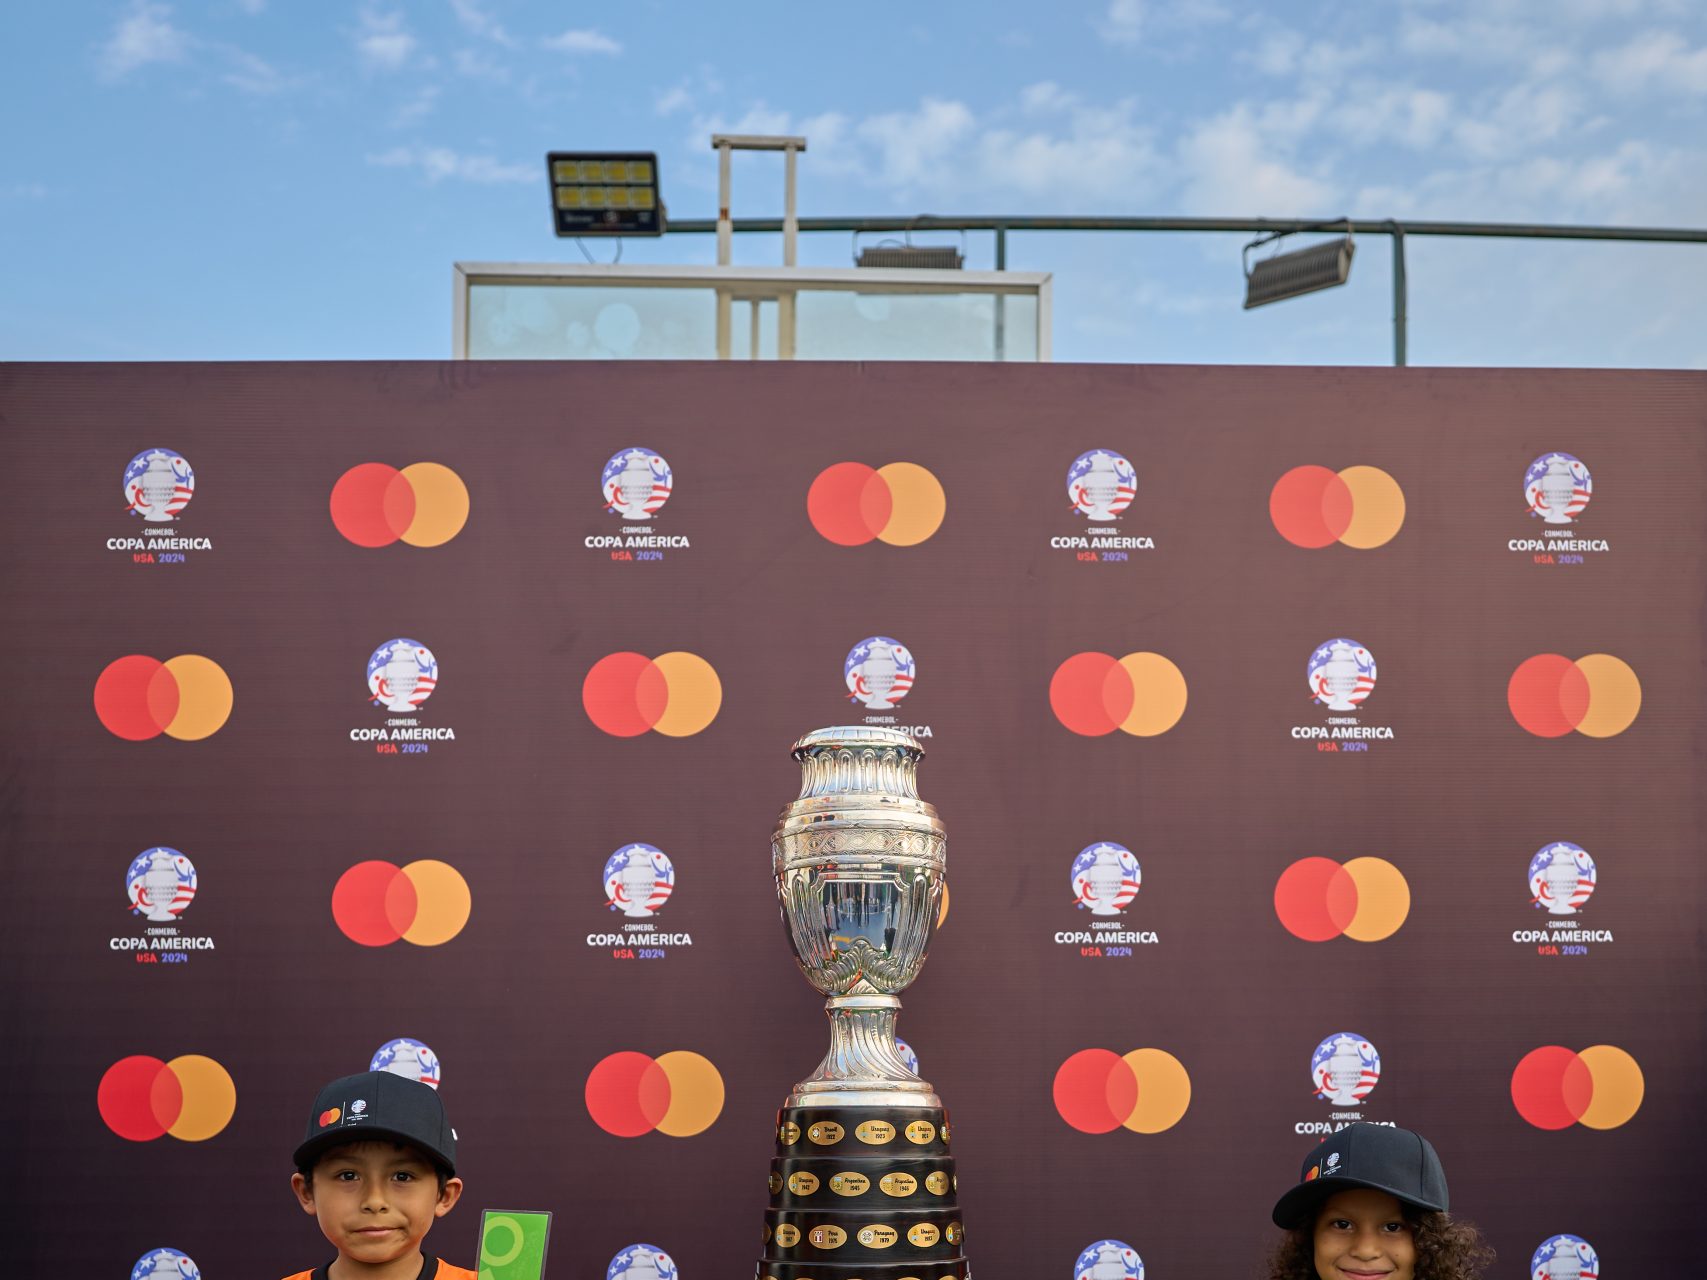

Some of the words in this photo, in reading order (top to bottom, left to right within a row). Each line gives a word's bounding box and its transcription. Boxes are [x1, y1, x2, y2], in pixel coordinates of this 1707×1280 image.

[107, 538, 145, 550] COPA
[147, 538, 212, 550] AMERICA
[585, 536, 623, 549] COPA
[625, 536, 690, 549] AMERICA
[1051, 537, 1089, 550] COPA
[1091, 537, 1155, 550] AMERICA
[1508, 540, 1545, 552] COPA
[1547, 540, 1609, 552] AMERICA
[133, 553, 154, 563] USA
[159, 553, 185, 563] 2024
[611, 551, 632, 561] USA
[637, 551, 663, 561] 2024
[1077, 552, 1098, 562] USA
[1103, 552, 1128, 562] 2024
[1534, 554, 1554, 564] USA
[1558, 554, 1584, 564] 2024
[350, 728, 388, 741] COPA
[390, 728, 455, 741] AMERICA
[1291, 727, 1329, 739] COPA
[1331, 727, 1394, 739] AMERICA
[377, 743, 398, 753] USA
[402, 743, 428, 753] 2024
[1317, 742, 1338, 752] USA
[1342, 742, 1368, 752] 2024
[587, 933, 625, 946] COPA
[627, 933, 692, 946] AMERICA
[1055, 932, 1093, 944] COPA
[1095, 932, 1159, 944] AMERICA
[1512, 930, 1549, 943] COPA
[1551, 930, 1613, 943] AMERICA
[110, 937, 148, 950] COPA
[150, 937, 214, 950] AMERICA
[613, 949, 634, 959] USA
[639, 949, 665, 959] 2024
[1081, 946, 1102, 957] USA
[1106, 946, 1132, 957] 2024
[1538, 945, 1558, 955] USA
[1562, 945, 1587, 955] 2024
[136, 952, 157, 963] USA
[161, 952, 188, 963] 2024
[1295, 1122, 1332, 1134] COPA
